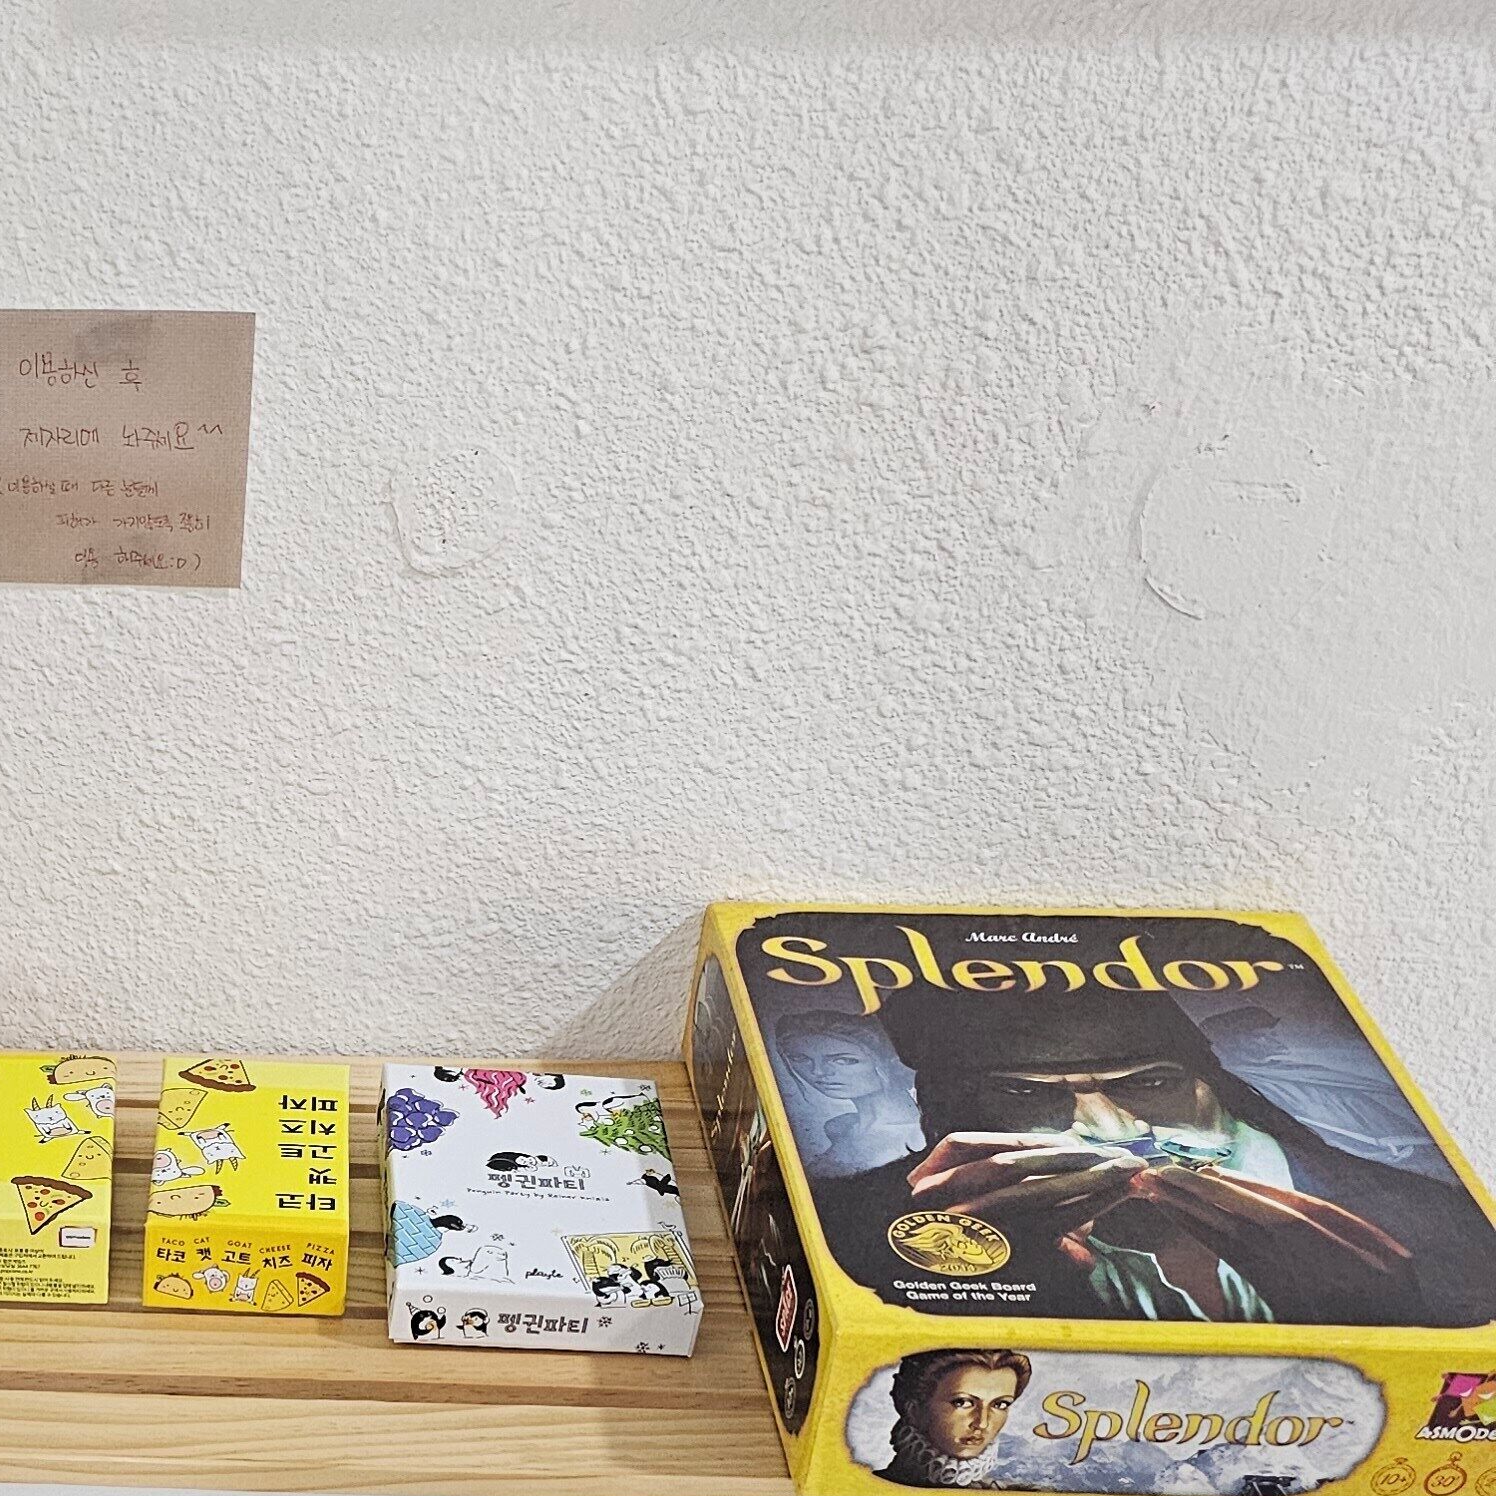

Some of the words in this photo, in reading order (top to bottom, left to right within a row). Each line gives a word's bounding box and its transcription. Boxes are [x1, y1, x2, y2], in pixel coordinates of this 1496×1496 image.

[19, 351, 99, 389] 이용하신
[119, 359, 142, 392] 후
[19, 427, 100, 449] 제자리에
[964, 930, 1018, 944] Marc
[1021, 930, 1080, 945] André
[760, 924, 1286, 1016] Splendor
[277, 1094, 339, 1112] 피자
[278, 1118, 337, 1136] 치즈
[277, 1143, 338, 1160] 고트
[307, 1166, 338, 1186] 캣
[487, 1172, 586, 1191] 펭귄파티
[274, 1192, 337, 1212] 타코
[892, 1214, 951, 1239] GOLDEN
[958, 1218, 1001, 1243] GEEK
[161, 1237, 186, 1247] TACO
[193, 1236, 211, 1245] CAT
[227, 1239, 253, 1249] GOAT
[259, 1244, 292, 1254] CHEESE
[306, 1242, 335, 1255] PIZZA
[156, 1247, 186, 1263] 타코
[195, 1246, 212, 1262] 캣
[221, 1250, 252, 1265] 고트
[261, 1254, 293, 1270] 치즈
[301, 1252, 333, 1271] 피자
[893, 1279, 947, 1291] Golden
[949, 1281, 989, 1291] Geek
[991, 1282, 1037, 1292] Board
[905, 1291, 950, 1301] Game
[952, 1291, 968, 1300] of
[971, 1291, 995, 1301] the
[998, 1292, 1032, 1302] Year
[497, 1313, 589, 1335] 펭귄파티
[1032, 1378, 1345, 1466] Splendor
